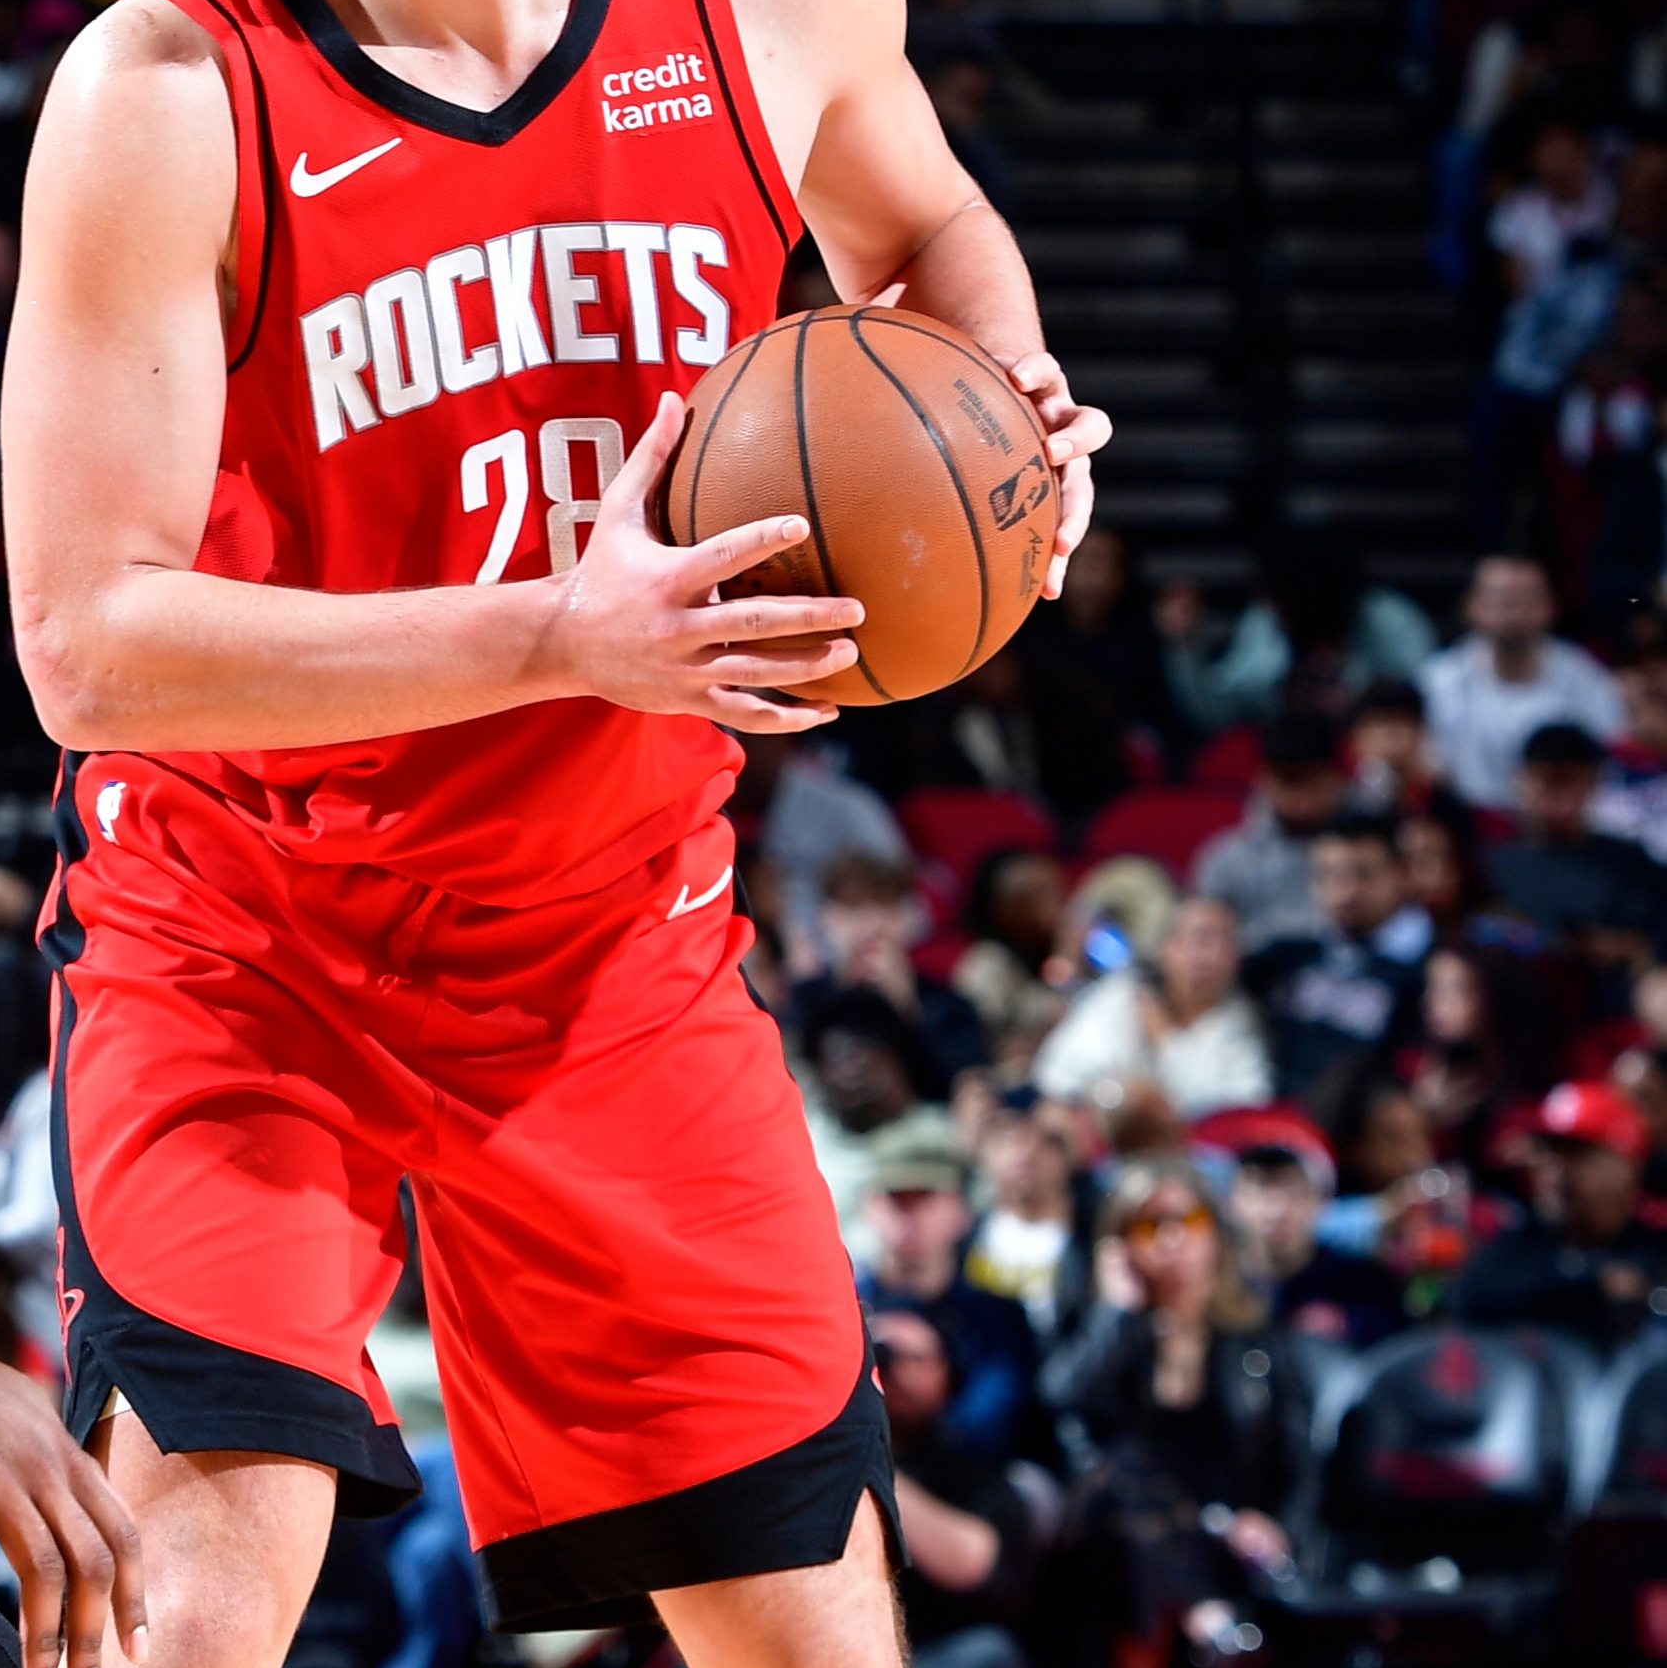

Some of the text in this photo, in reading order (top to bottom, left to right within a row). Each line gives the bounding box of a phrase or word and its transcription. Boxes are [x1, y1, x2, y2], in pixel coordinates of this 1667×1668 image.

[601, 93, 713, 133] karma
[602, 52, 707, 97] credit
[299, 220, 731, 454] ROCKETS
[460, 417, 625, 586] 28
